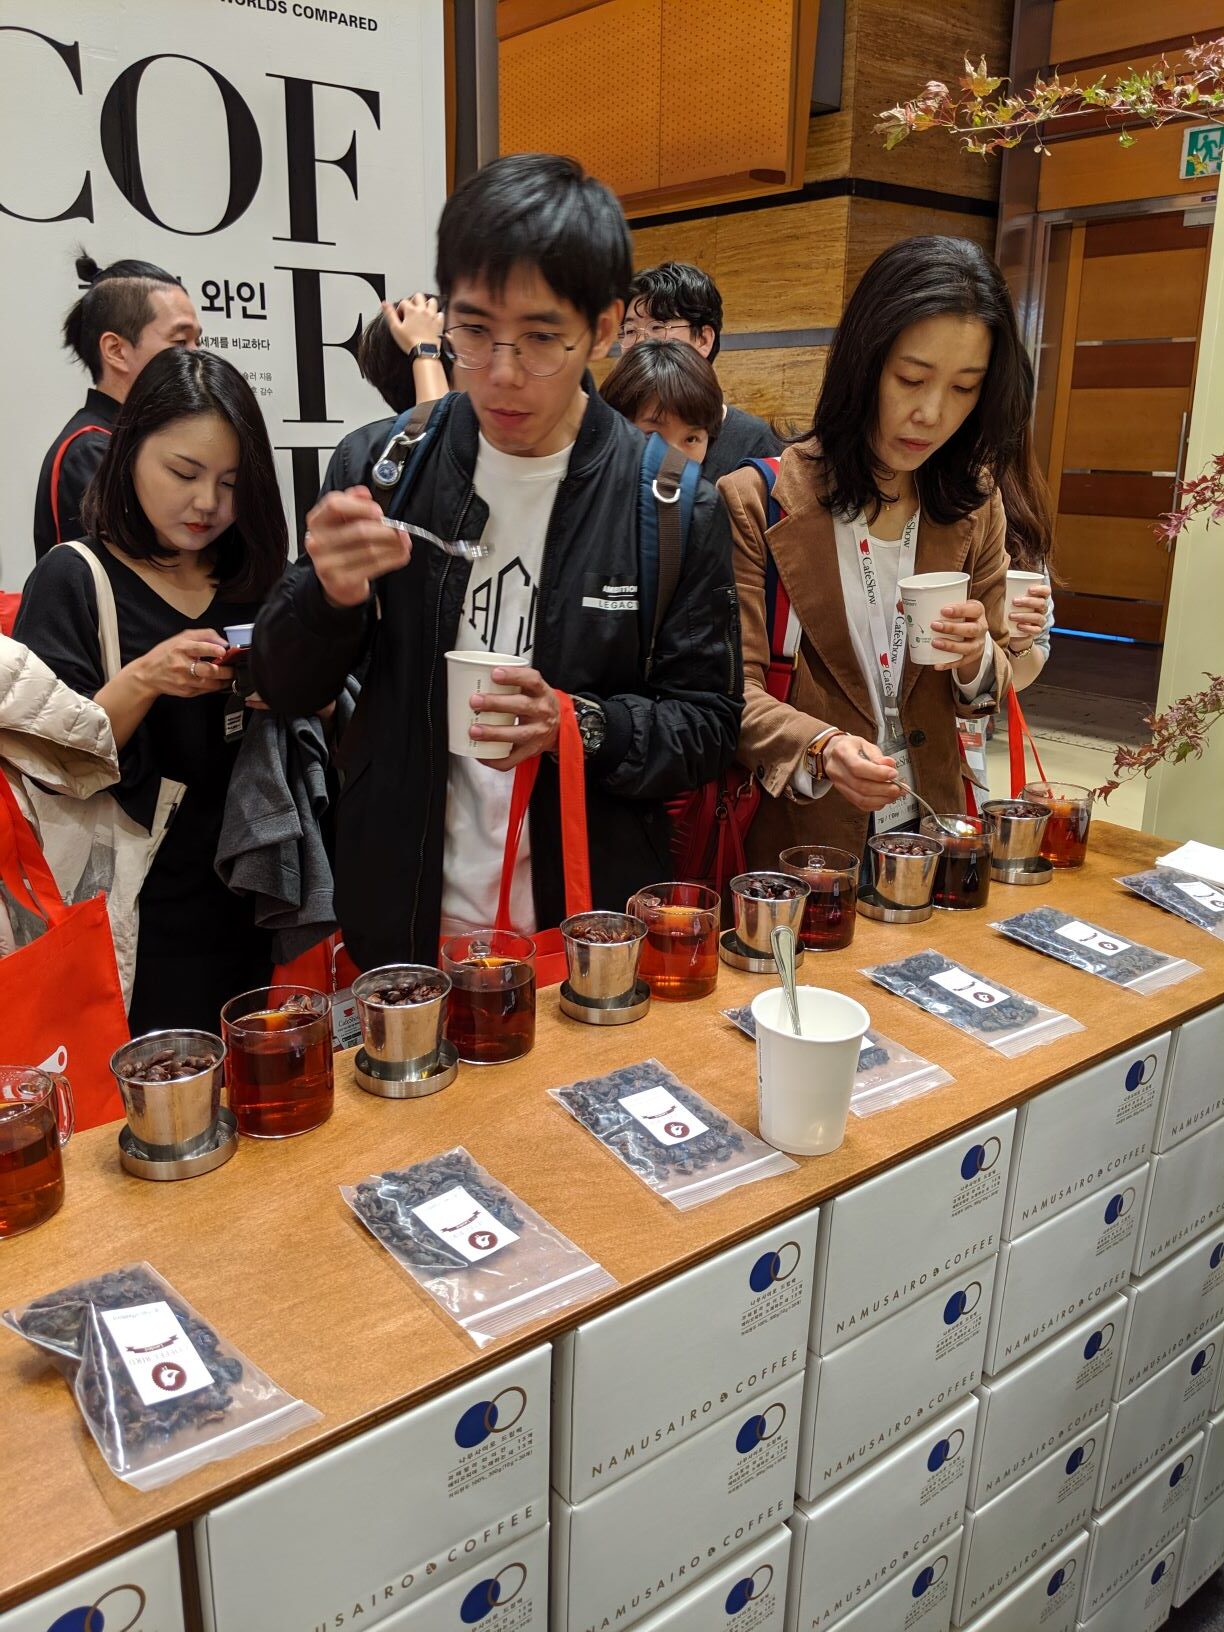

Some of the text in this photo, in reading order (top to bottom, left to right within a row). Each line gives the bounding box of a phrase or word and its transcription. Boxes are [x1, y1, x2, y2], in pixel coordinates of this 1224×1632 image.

[221, 0, 378, 32] RLDS COMPARED
[201, 279, 267, 320] 와인
[232, 338, 271, 350] 비교하다
[259, 372, 272, 382] 지음
[598, 600, 639, 609] LEGAC
[862, 556, 876, 606] CafeShow
[891, 616, 907, 665] CafeShow
[1022, 1174, 1094, 1221] NAMUSAIRO
[1106, 1143, 1146, 1173] COFFEE
[1150, 1215, 1205, 1259] NAMUSAIRO
[836, 1273, 927, 1334] NAMUSAIRO
[944, 1234, 994, 1270] COFFEE
[1005, 1305, 1075, 1356] NAMUSAIRO
[1087, 1269, 1126, 1301] COFFEE
[591, 1401, 712, 1478] NAMUSAIRO
[735, 1349, 798, 1394] COFFEE
[824, 1415, 911, 1481] NAMUSAIRO
[928, 1370, 975, 1409] COFFEE
[985, 1436, 1055, 1491] NAMUSAIRO
[447, 1505, 533, 1562] COFFEE
[586, 1556, 700, 1632] NAMUSAIRO
[723, 1500, 784, 1546] COFFEE
[811, 1559, 897, 1629] NAMUSAIRO
[913, 1511, 959, 1550] COFFEE
